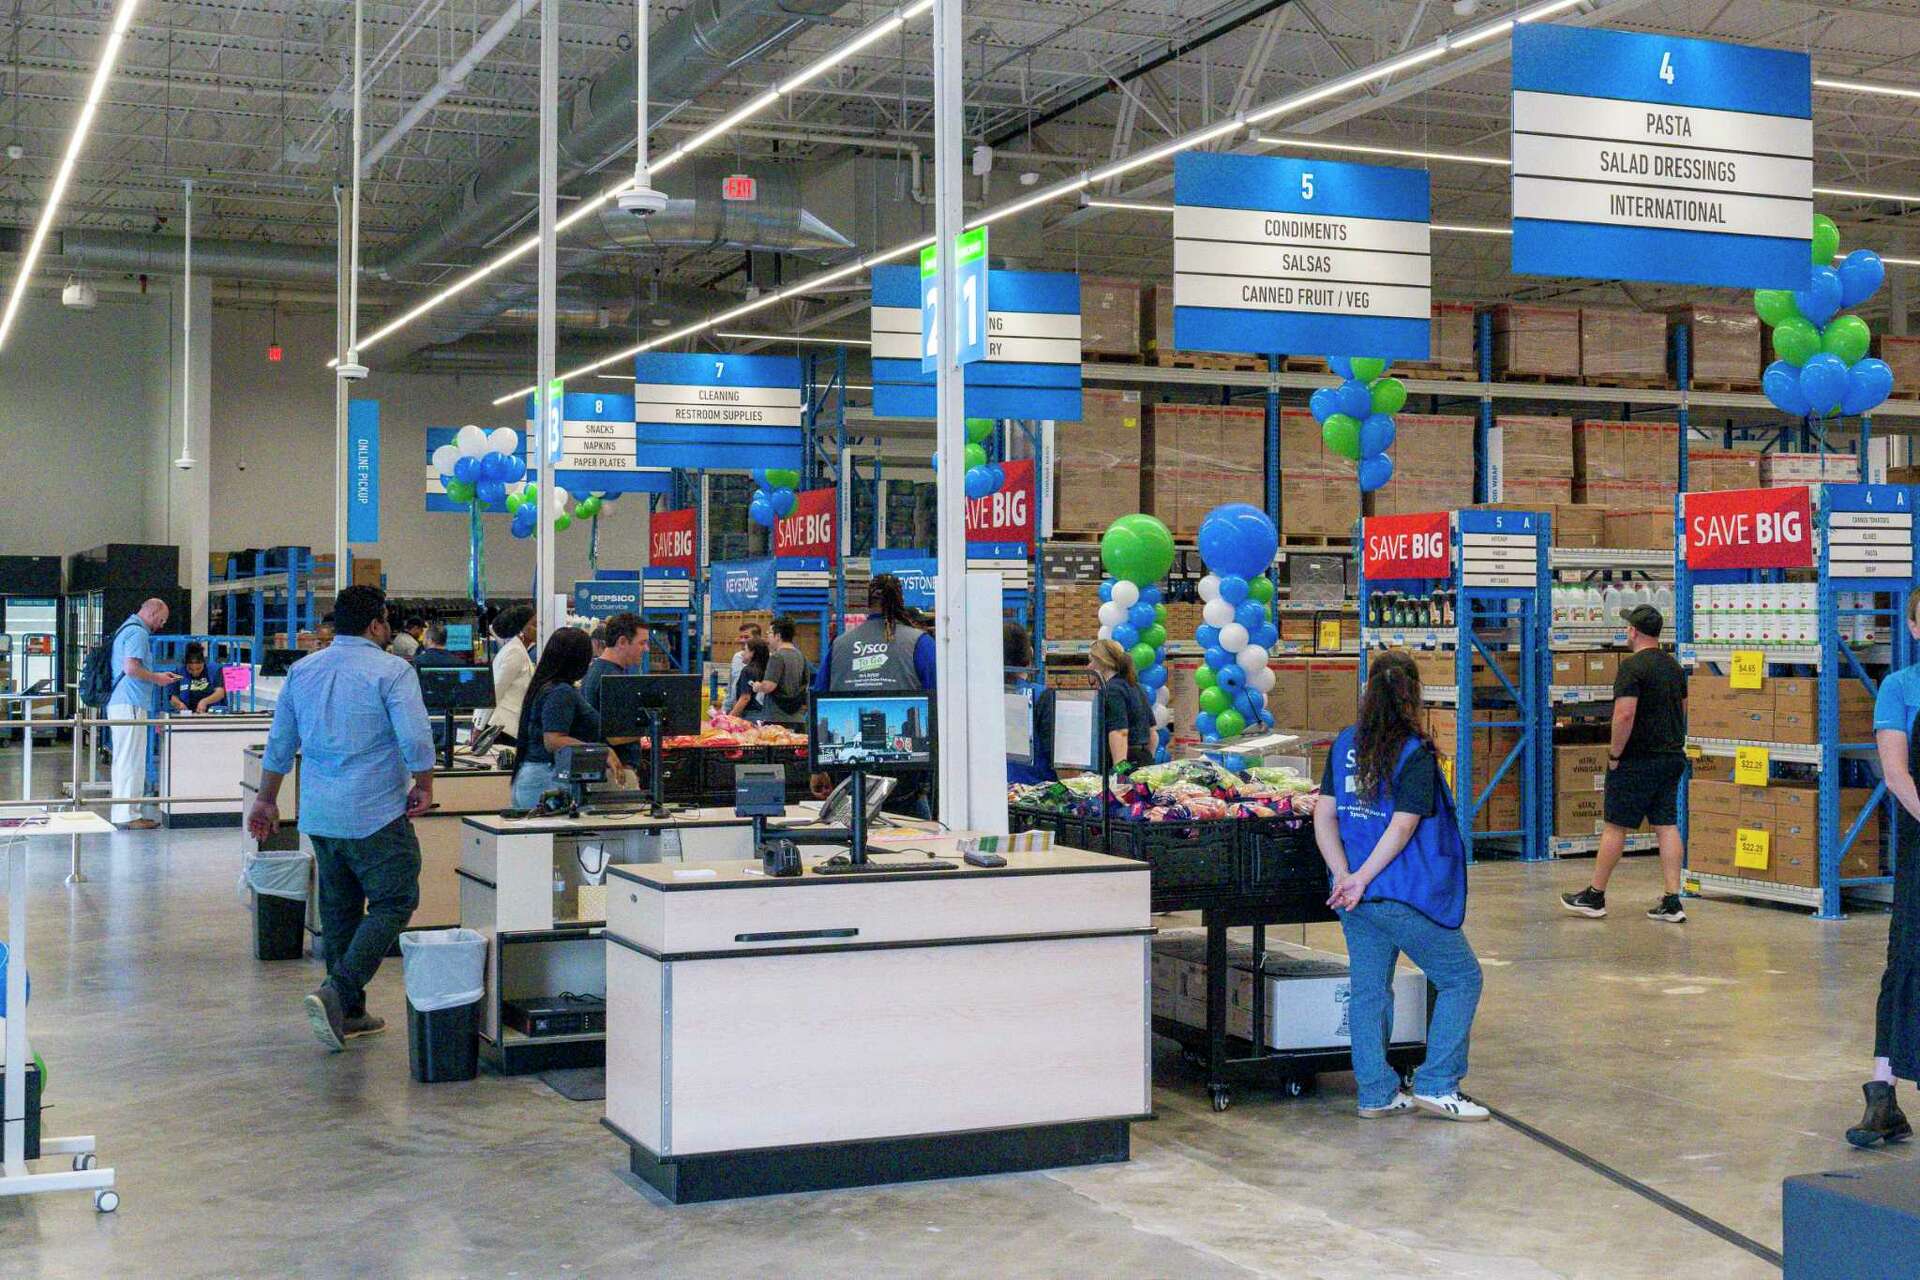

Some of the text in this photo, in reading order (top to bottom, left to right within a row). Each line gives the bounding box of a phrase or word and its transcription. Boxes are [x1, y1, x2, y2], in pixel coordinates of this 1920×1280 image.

[1658, 52, 1675, 85] 4
[1646, 112, 1692, 137] PASTA
[1600, 151, 1736, 183] SALAD DRESSINGS
[1301, 173, 1314, 200] 5
[1610, 194, 1726, 224] INTERNATIONAL
[1264, 219, 1347, 241] CONDIMENTS
[1282, 253, 1331, 274] SALSAS
[1242, 285, 1293, 305] CANNED
[1298, 288, 1334, 306] FRUIT
[1346, 291, 1370, 309] VEG
[963, 274, 977, 346] 1
[715, 362, 724, 379] 7
[595, 399, 603, 414] 8
[698, 390, 740, 402] CLEANING
[675, 408, 763, 422] RESTROOM SUPPLIES
[585, 424, 615, 434] SNACKS
[583, 440, 616, 451] NAPKINS
[358, 438, 369, 505] ONLINE PICKUP
[573, 457, 626, 468] PAPER PLATES
[965, 489, 1027, 530] AVE BIG
[1865, 491, 1904, 506] 4 A
[777, 512, 831, 548] SAVE BIG
[1496, 516, 1530, 529] 5 A
[1693, 511, 1802, 547] SAVE BIG
[653, 529, 692, 558] SAVE BIG
[1369, 532, 1443, 561] SAVE BIG
[725, 576, 759, 593] KEYSTONE
[590, 594, 636, 602] PEPSICO
[853, 641, 888, 656] Sysco
